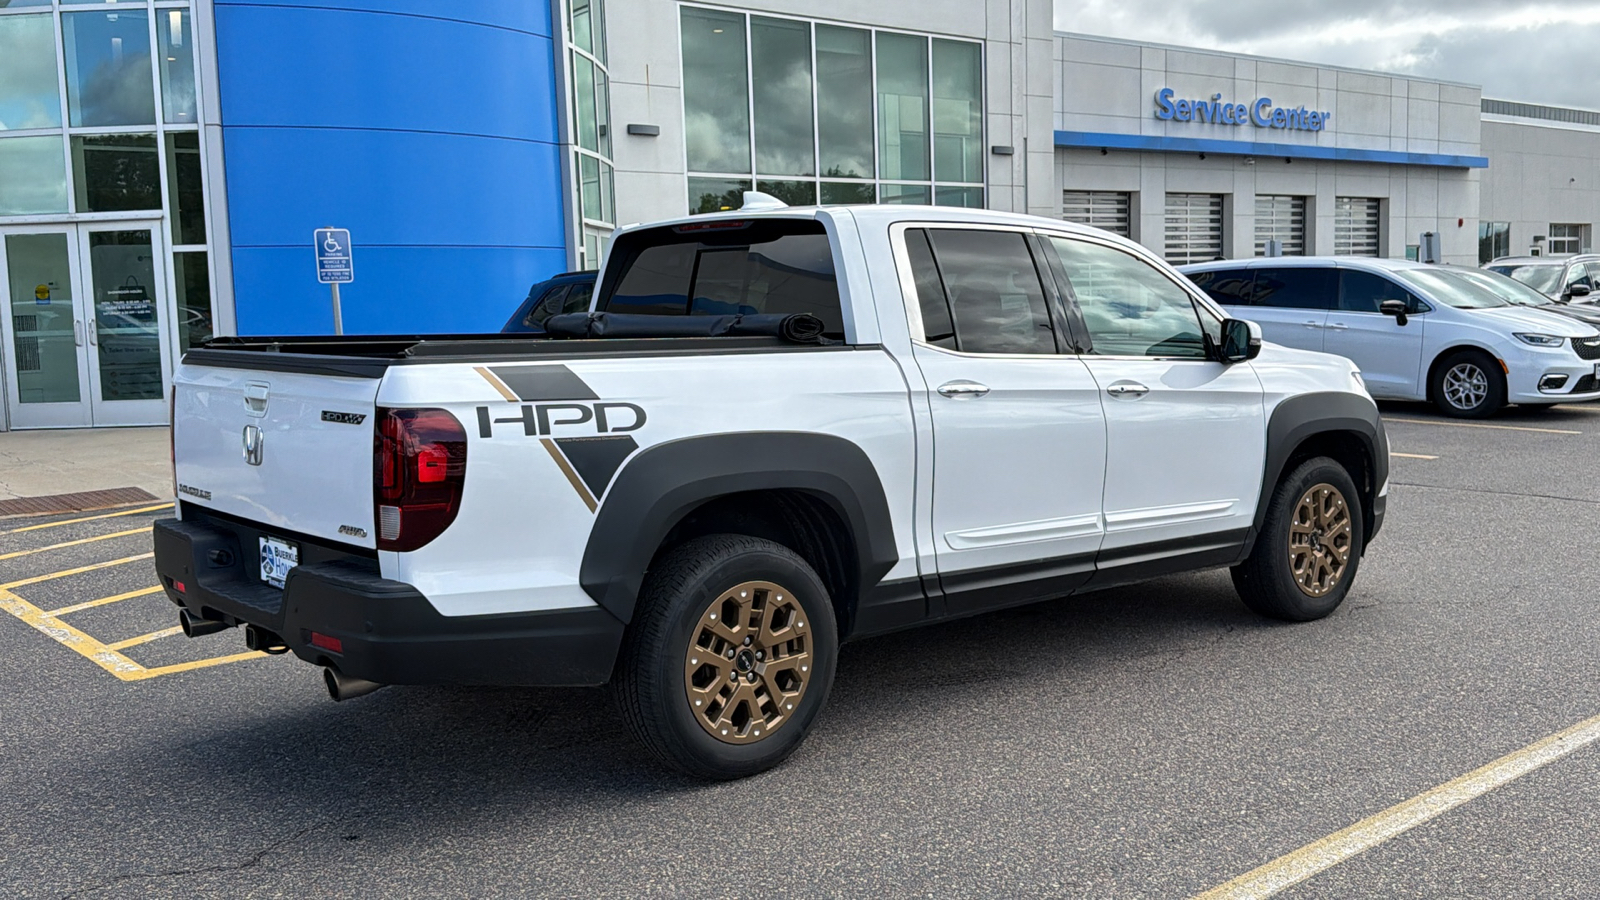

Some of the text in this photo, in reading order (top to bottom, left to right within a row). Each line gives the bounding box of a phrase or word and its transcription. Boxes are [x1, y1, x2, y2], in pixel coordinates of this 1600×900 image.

[1154, 88, 1331, 131] Service Center
[476, 402, 647, 438] HPD
[275, 558, 293, 576] HON
